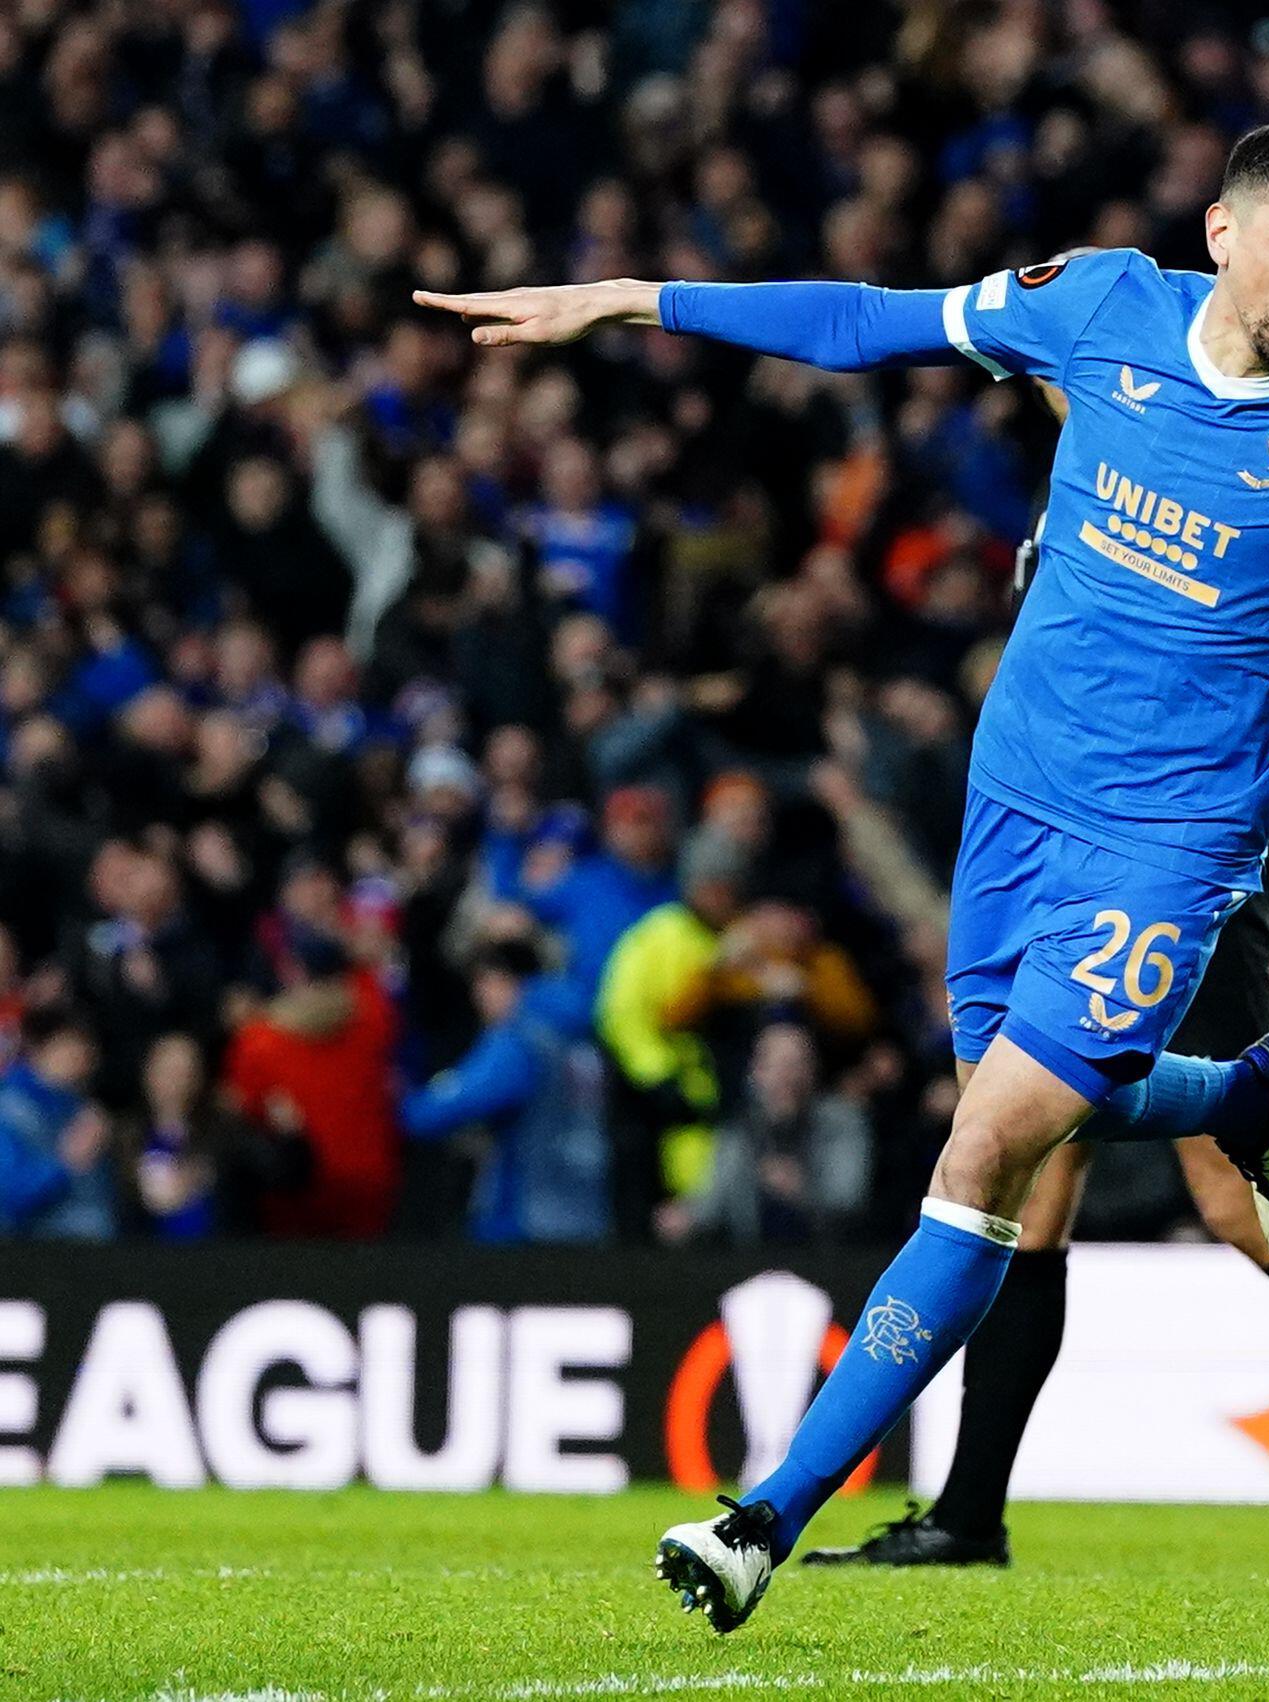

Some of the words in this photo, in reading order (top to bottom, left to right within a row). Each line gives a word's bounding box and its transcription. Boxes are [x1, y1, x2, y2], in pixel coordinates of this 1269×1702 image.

[1096, 461, 1242, 559] UNIBET
[1100, 540, 1120, 555] SET
[1122, 551, 1151, 572] YOUR
[1152, 566, 1191, 592] LIMITS
[1070, 909, 1182, 1008] 26
